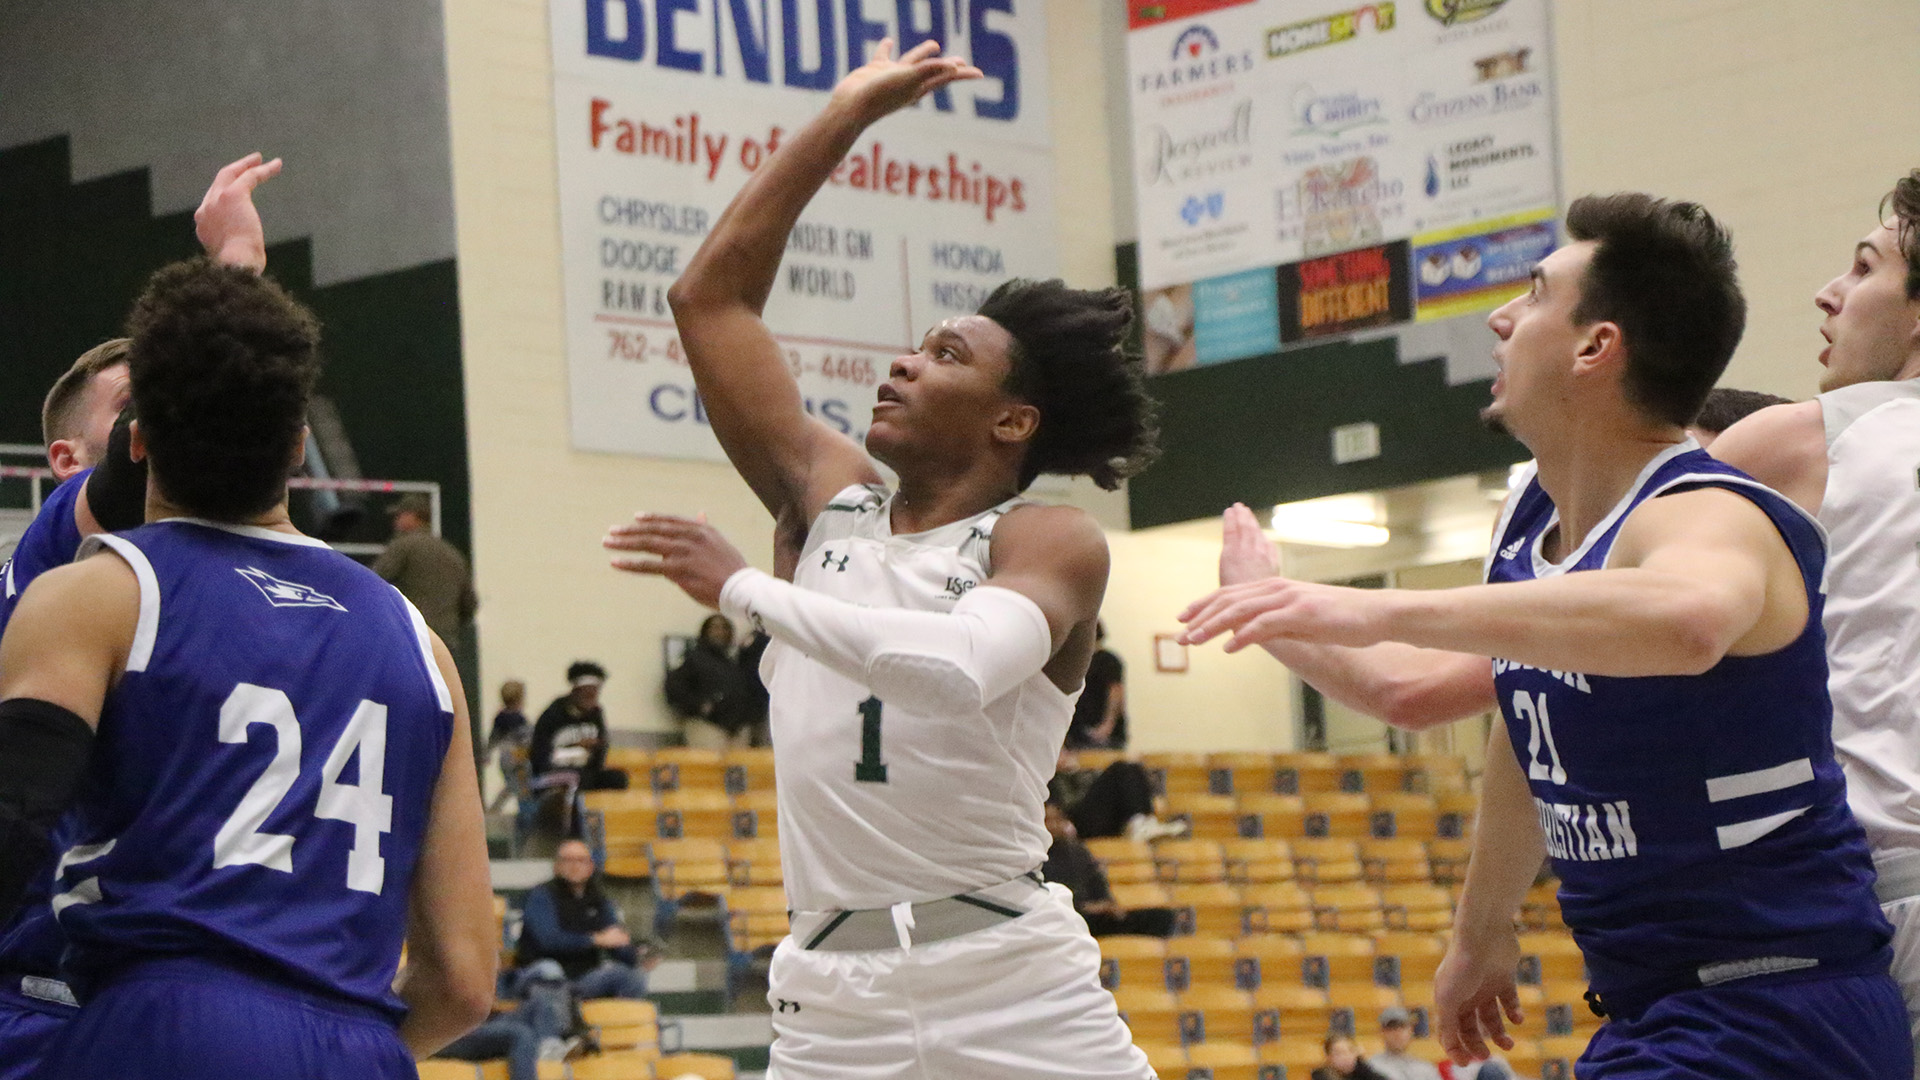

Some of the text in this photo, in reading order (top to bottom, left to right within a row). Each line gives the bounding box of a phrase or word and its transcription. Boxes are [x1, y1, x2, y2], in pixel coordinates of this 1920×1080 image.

[1140, 52, 1254, 92] FARMERS
[589, 98, 728, 180] Family
[829, 143, 1026, 222] ealerships
[599, 196, 709, 235] CHRYSLER
[601, 238, 679, 276] DODGE
[788, 222, 838, 258] NDER
[931, 241, 1005, 274] HONDA
[788, 264, 856, 300] WORLD
[855, 695, 889, 784] 1
[1512, 689, 1567, 785] 21
[213, 682, 393, 896] 24
